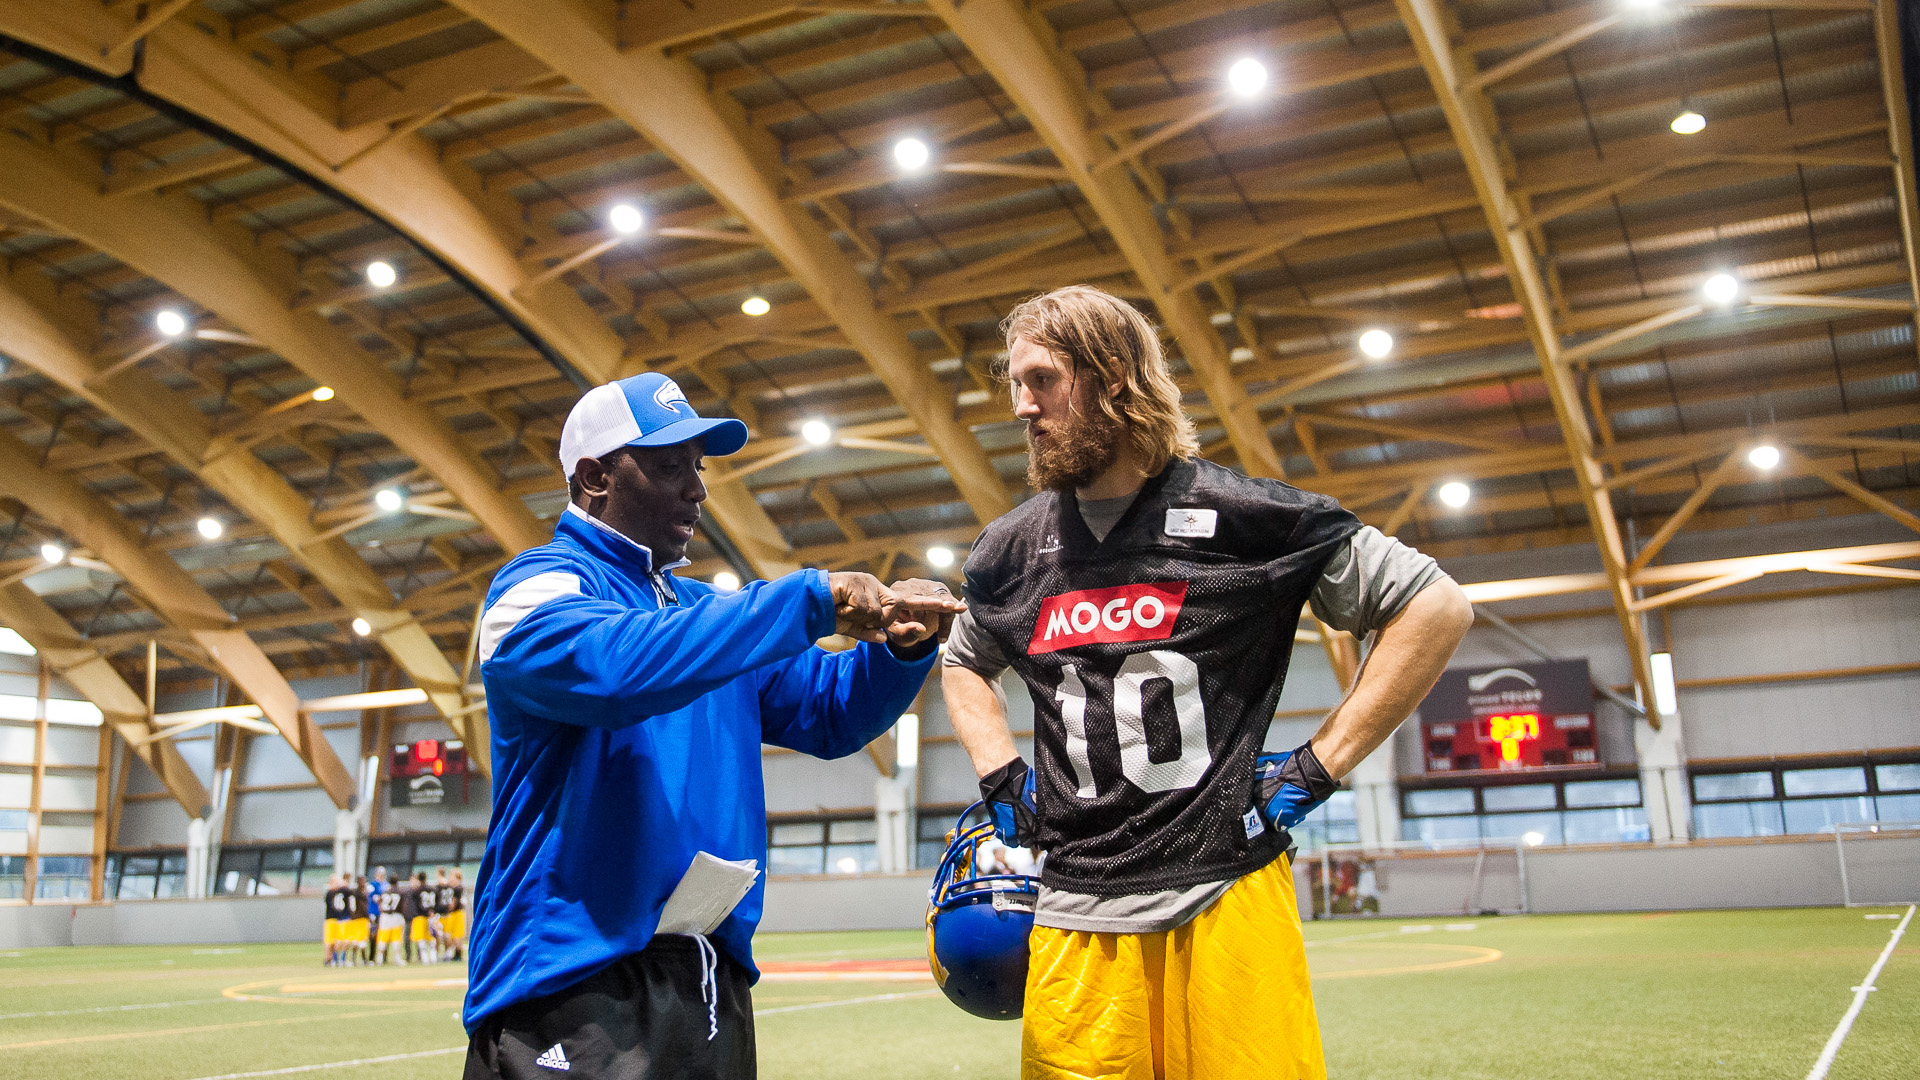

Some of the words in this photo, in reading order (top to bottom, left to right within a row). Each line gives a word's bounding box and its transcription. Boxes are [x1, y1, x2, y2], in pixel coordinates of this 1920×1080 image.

[1043, 595, 1165, 641] MOGO
[1055, 650, 1212, 799] 10
[536, 1057, 571, 1071] adidas
